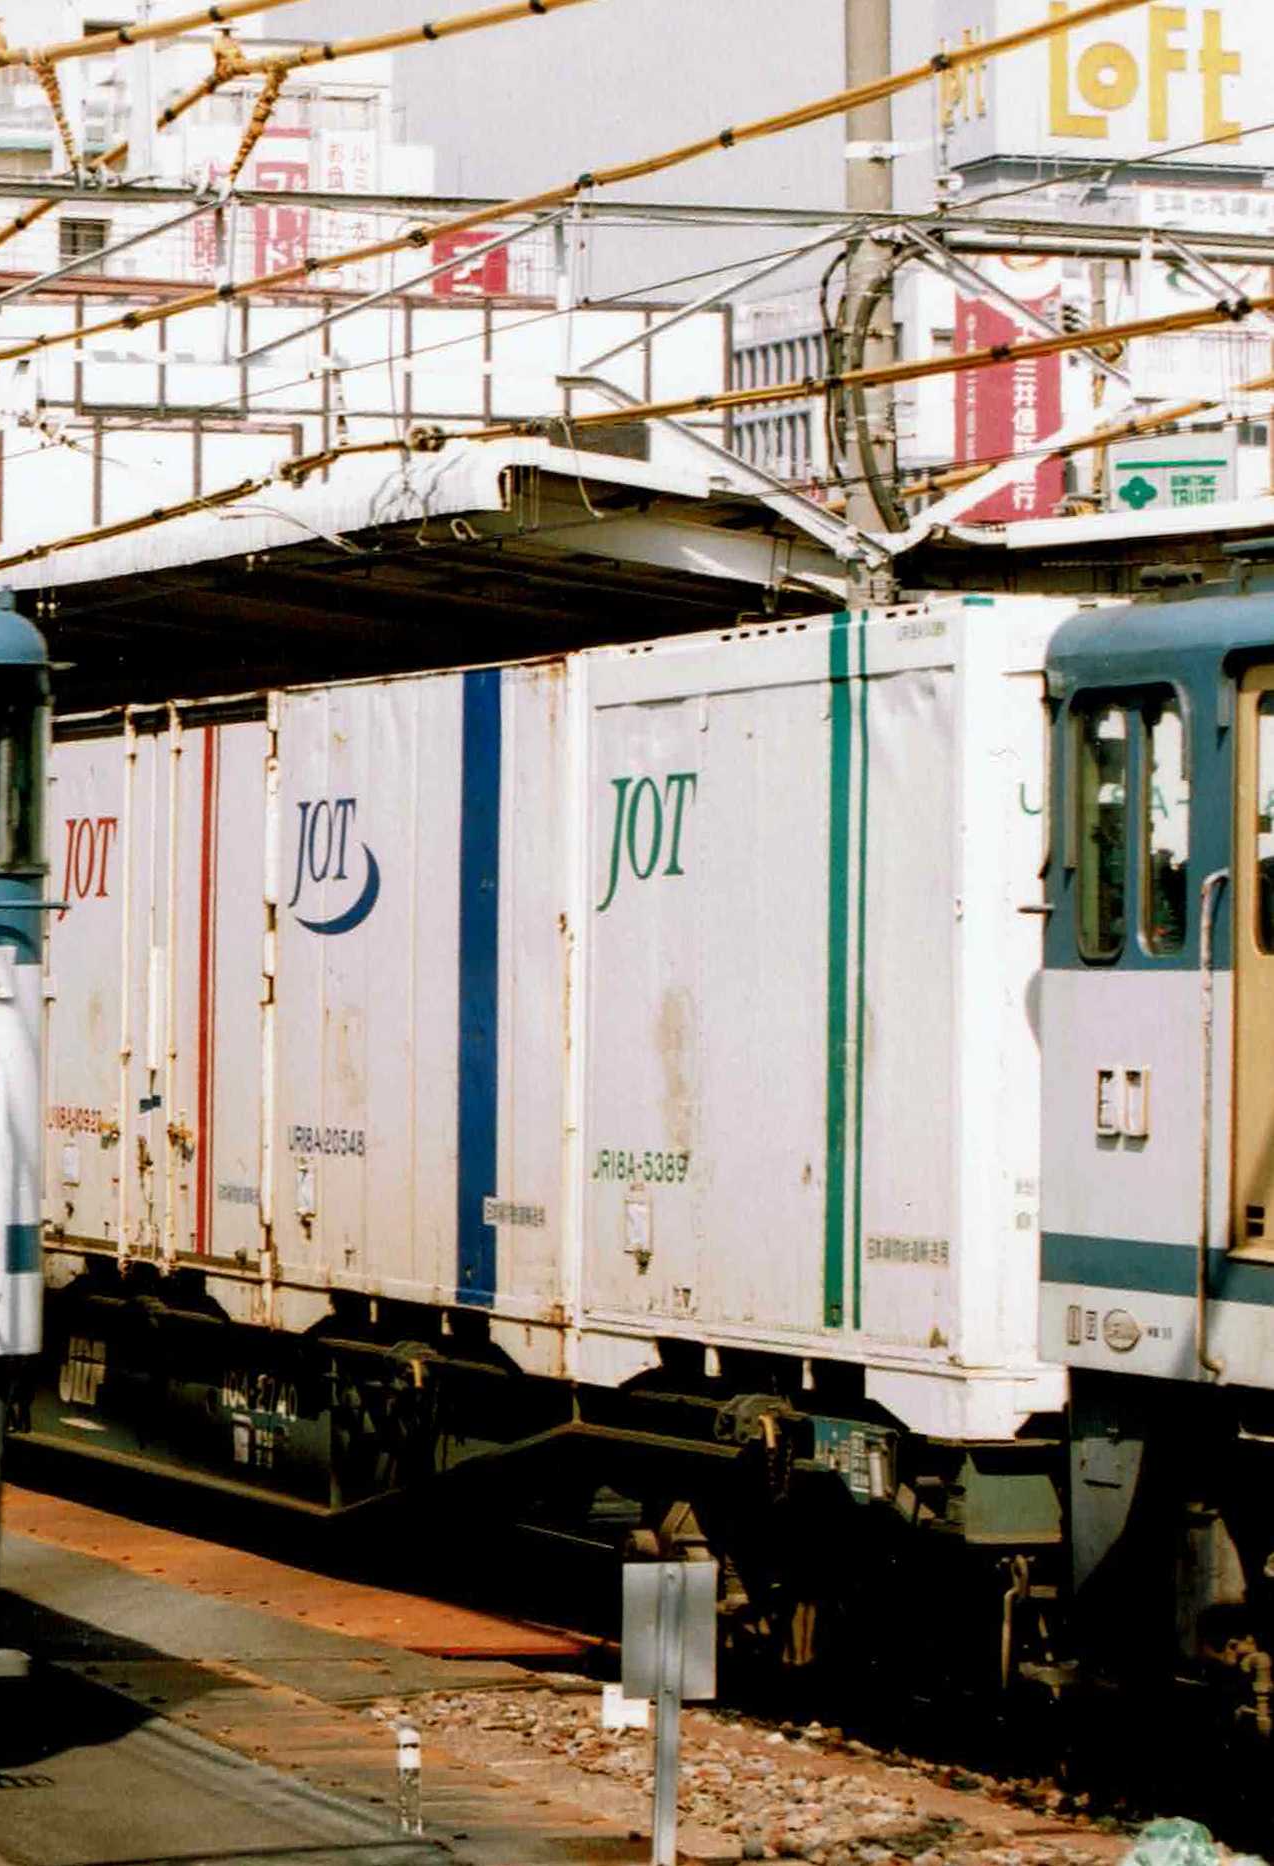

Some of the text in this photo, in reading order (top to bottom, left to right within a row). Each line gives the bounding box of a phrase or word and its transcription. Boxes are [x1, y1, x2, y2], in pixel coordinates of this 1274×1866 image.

[57, 816, 118, 922] JOT
[287, 797, 357, 909] JOT
[595, 772, 698, 912] JOT
